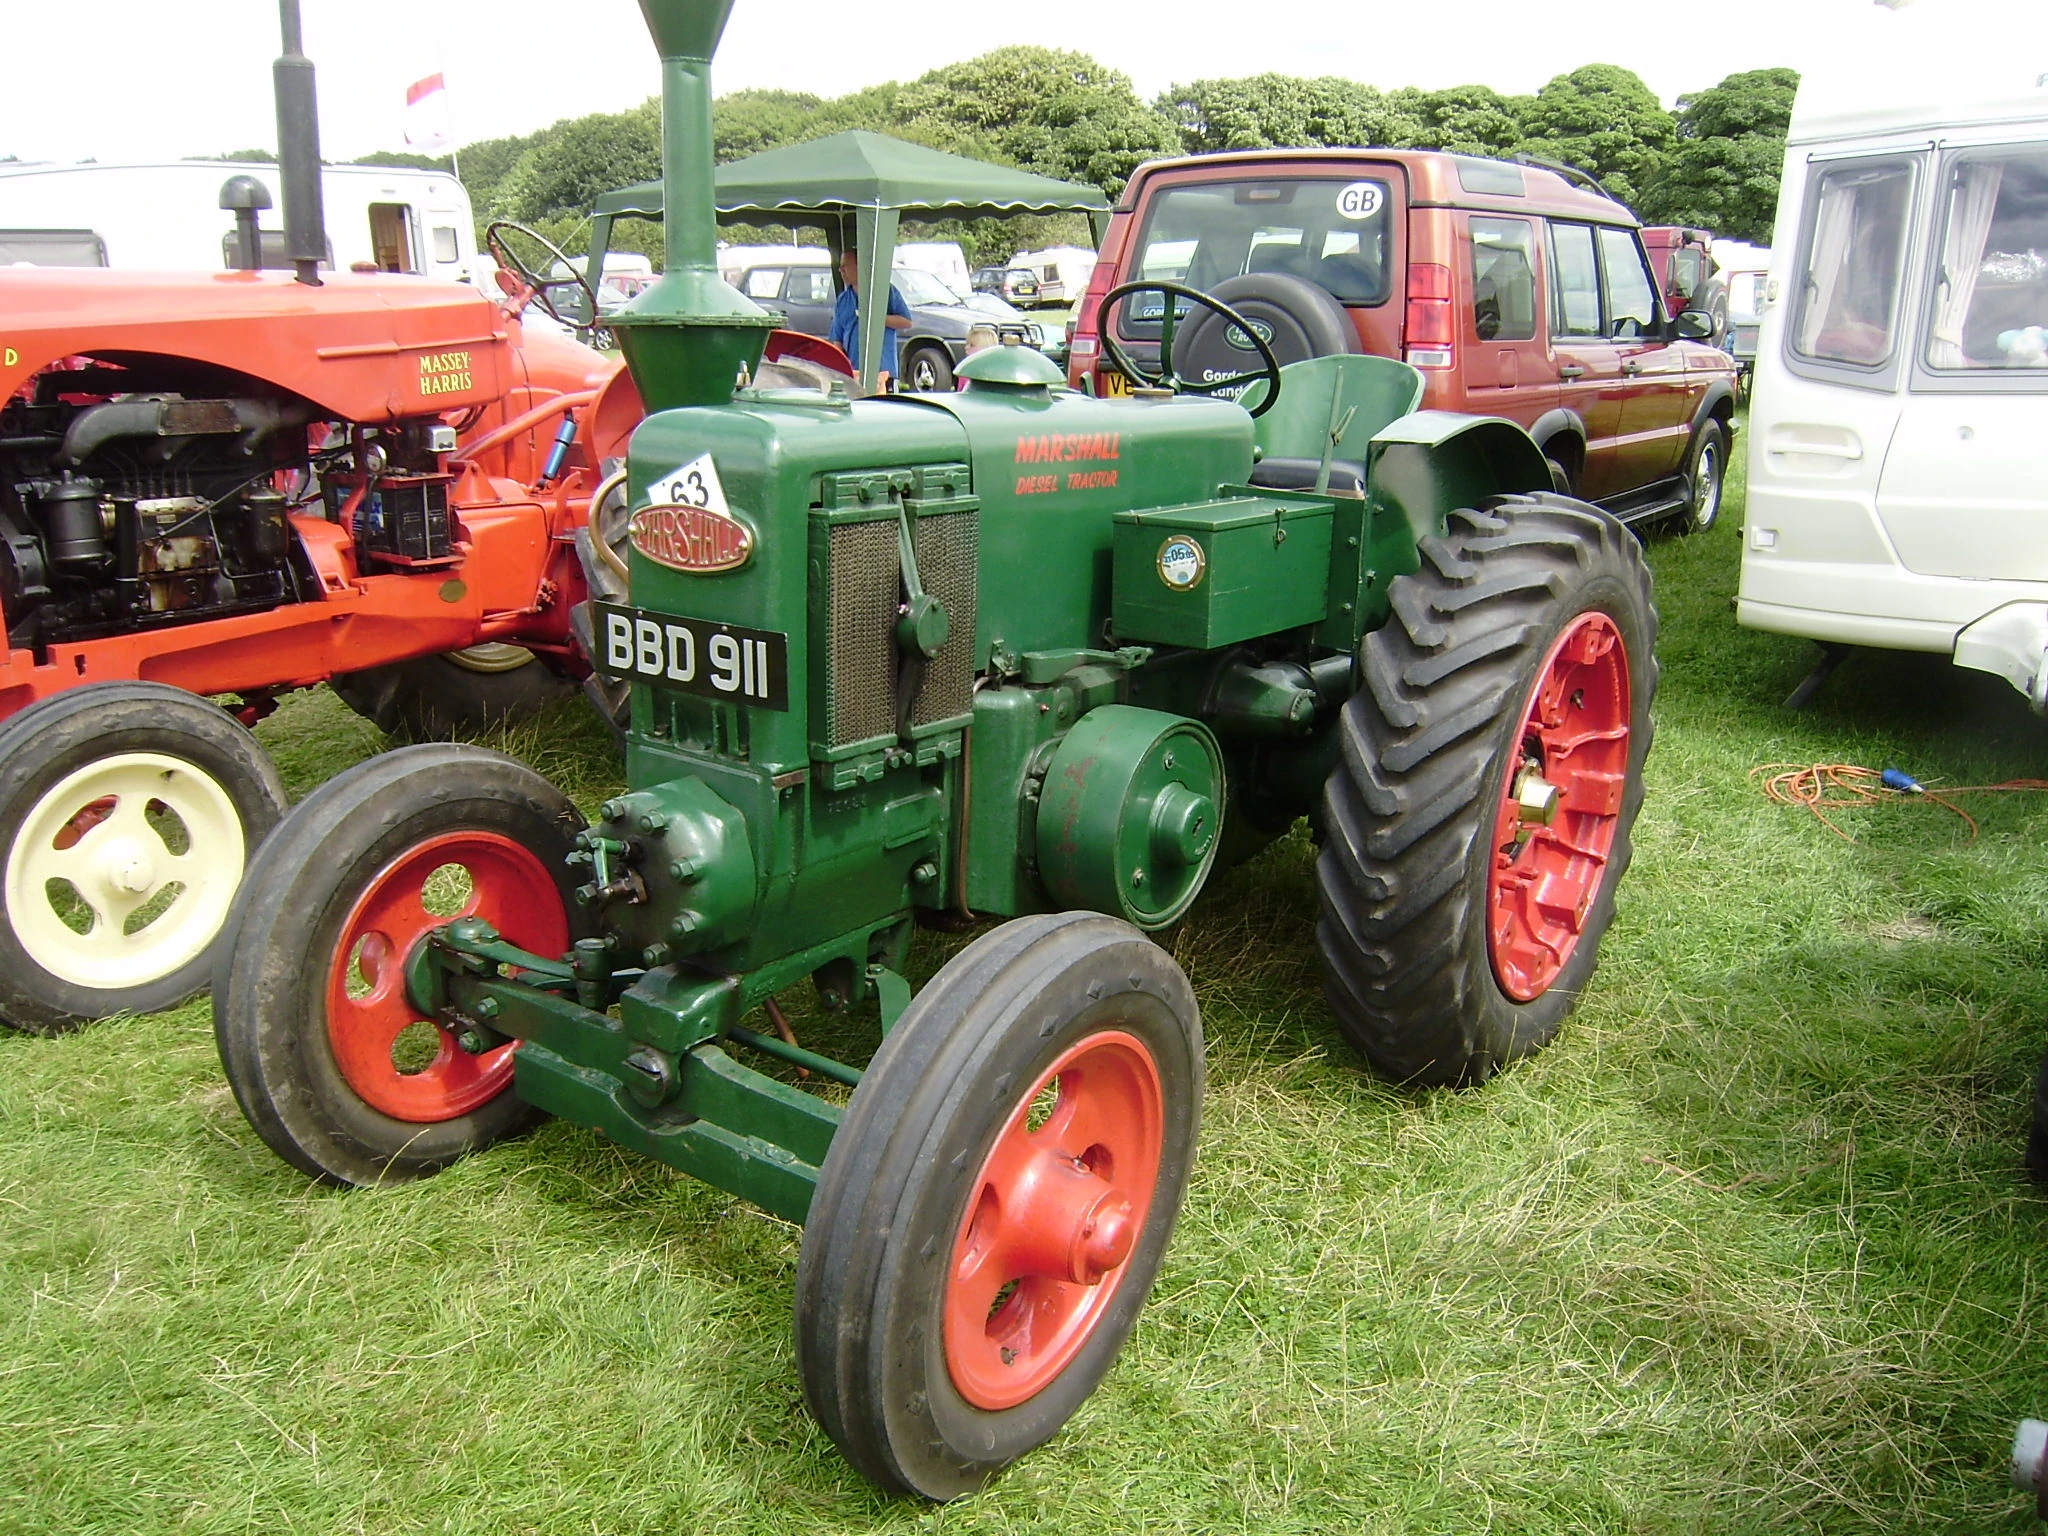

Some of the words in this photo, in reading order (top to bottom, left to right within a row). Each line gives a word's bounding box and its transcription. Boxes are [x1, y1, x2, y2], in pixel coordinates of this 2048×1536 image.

[1342, 190, 1376, 212] GB
[5, 347, 18, 366] D
[420, 372, 472, 395] HARRIS
[1014, 432, 1120, 464] MARSHALL
[671, 471, 709, 508] 63
[1015, 475, 1058, 495] DIESEL
[1066, 469, 1118, 490] TRACTOR
[634, 509, 743, 566] MARSHALL
[1171, 548, 1185, 562] 05
[607, 612, 696, 683] BBD
[709, 633, 769, 699] 911
